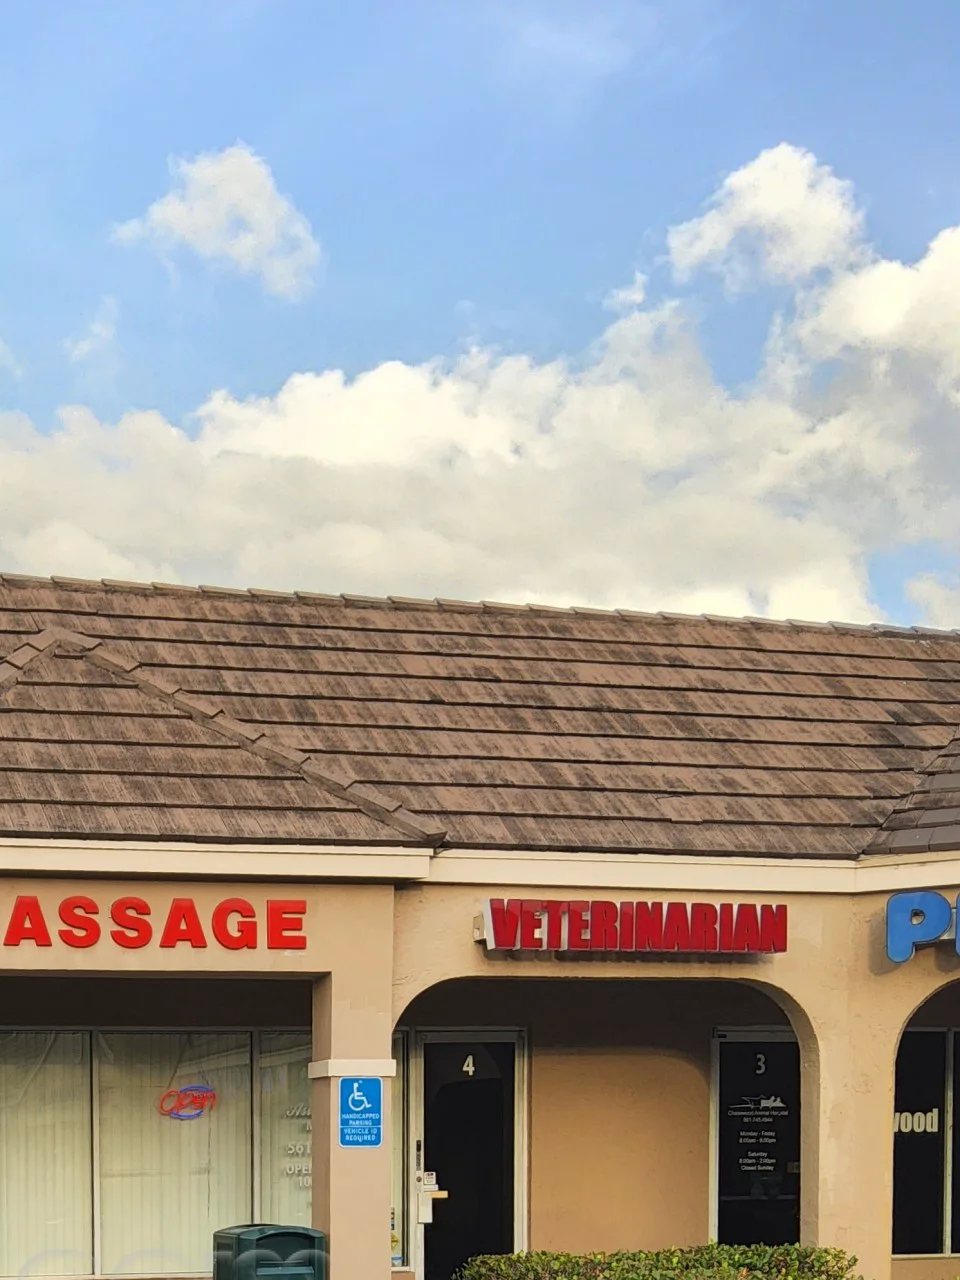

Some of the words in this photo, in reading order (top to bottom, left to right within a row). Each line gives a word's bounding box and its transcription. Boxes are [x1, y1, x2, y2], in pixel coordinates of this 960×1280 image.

[487, 898, 788, 953] VETERINARIAN
[887, 890, 960, 963] P
[462, 1054, 475, 1076] 4
[755, 1053, 766, 1074] 3
